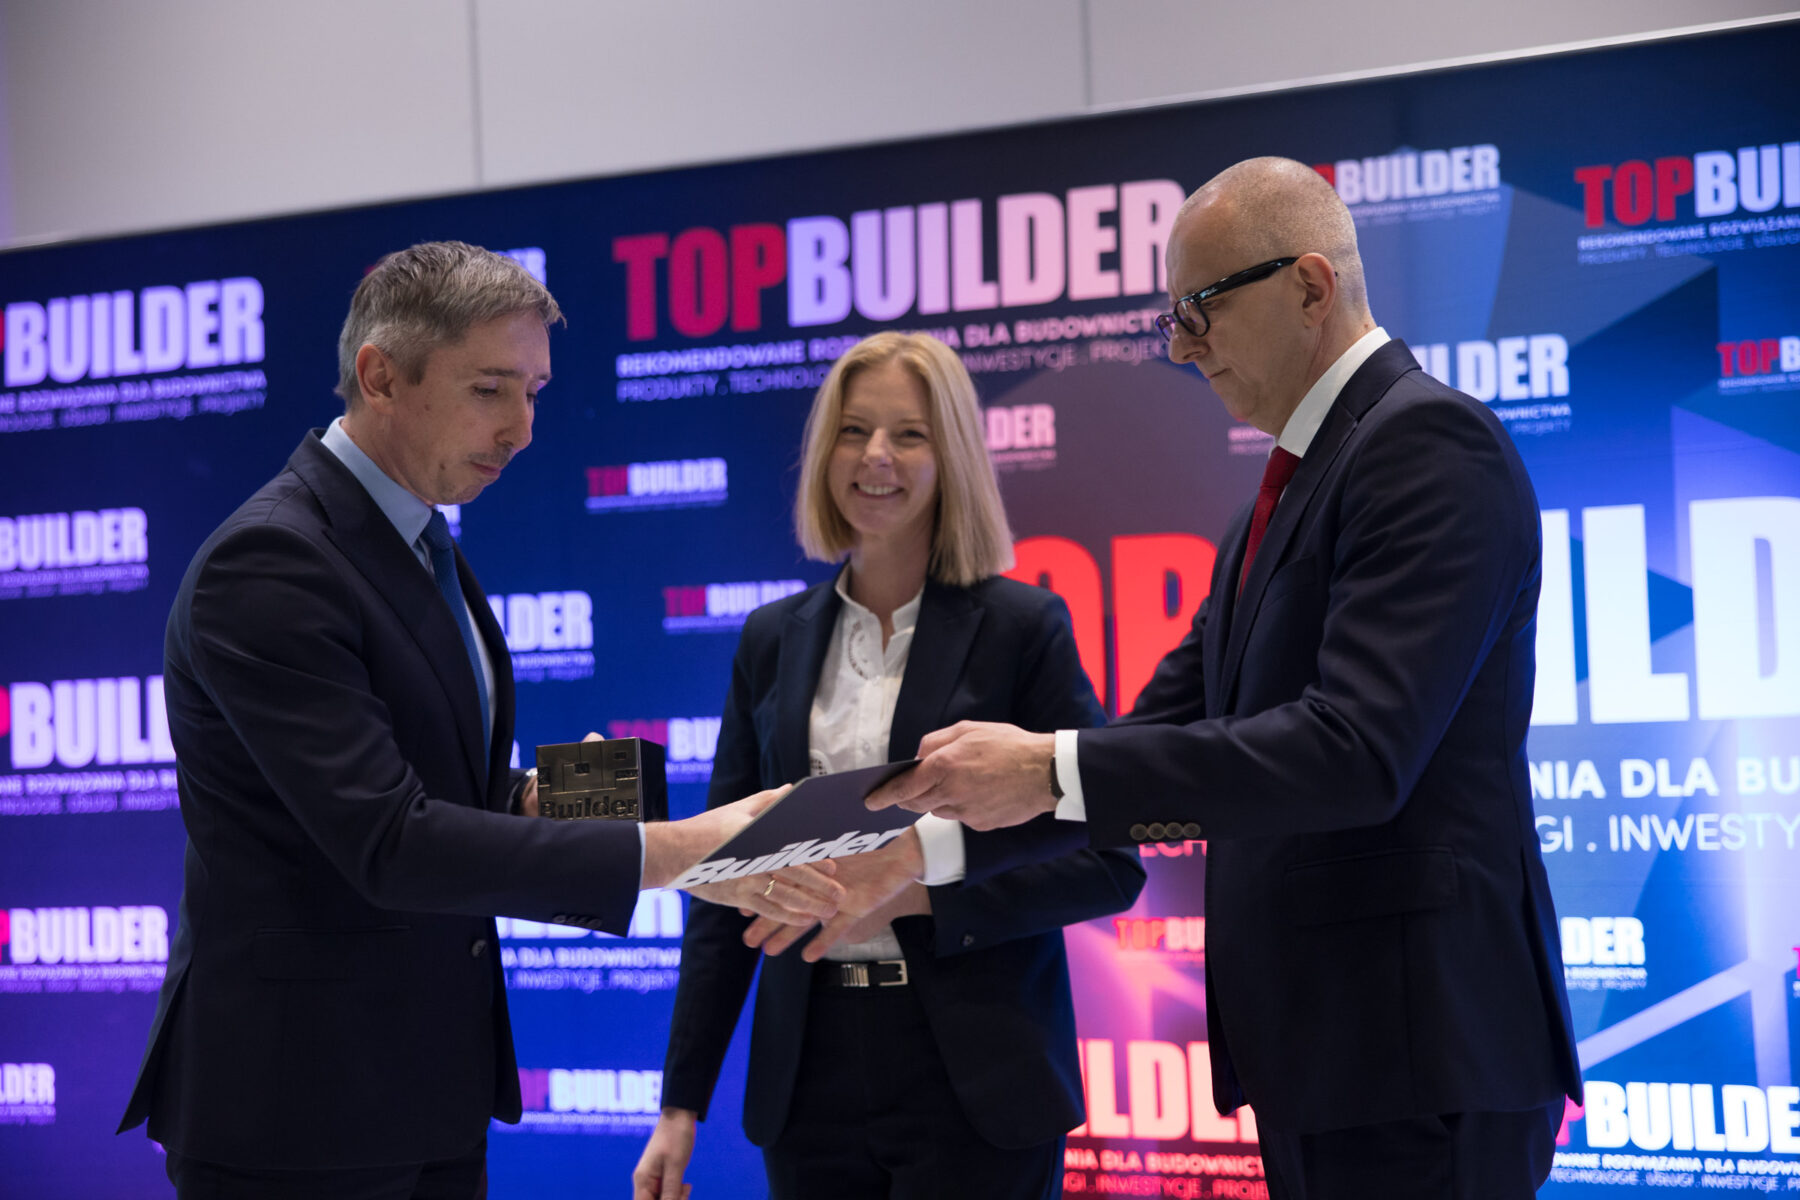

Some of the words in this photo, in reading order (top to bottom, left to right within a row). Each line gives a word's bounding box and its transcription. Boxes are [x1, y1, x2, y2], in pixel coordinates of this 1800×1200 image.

[612, 178, 1187, 341] TOPBUILDER
[0, 276, 266, 388] BUILDER
[1013, 307, 1165, 345] BUDOWNICT
[1620, 757, 1719, 799] DLA
[664, 826, 909, 889] Builder
